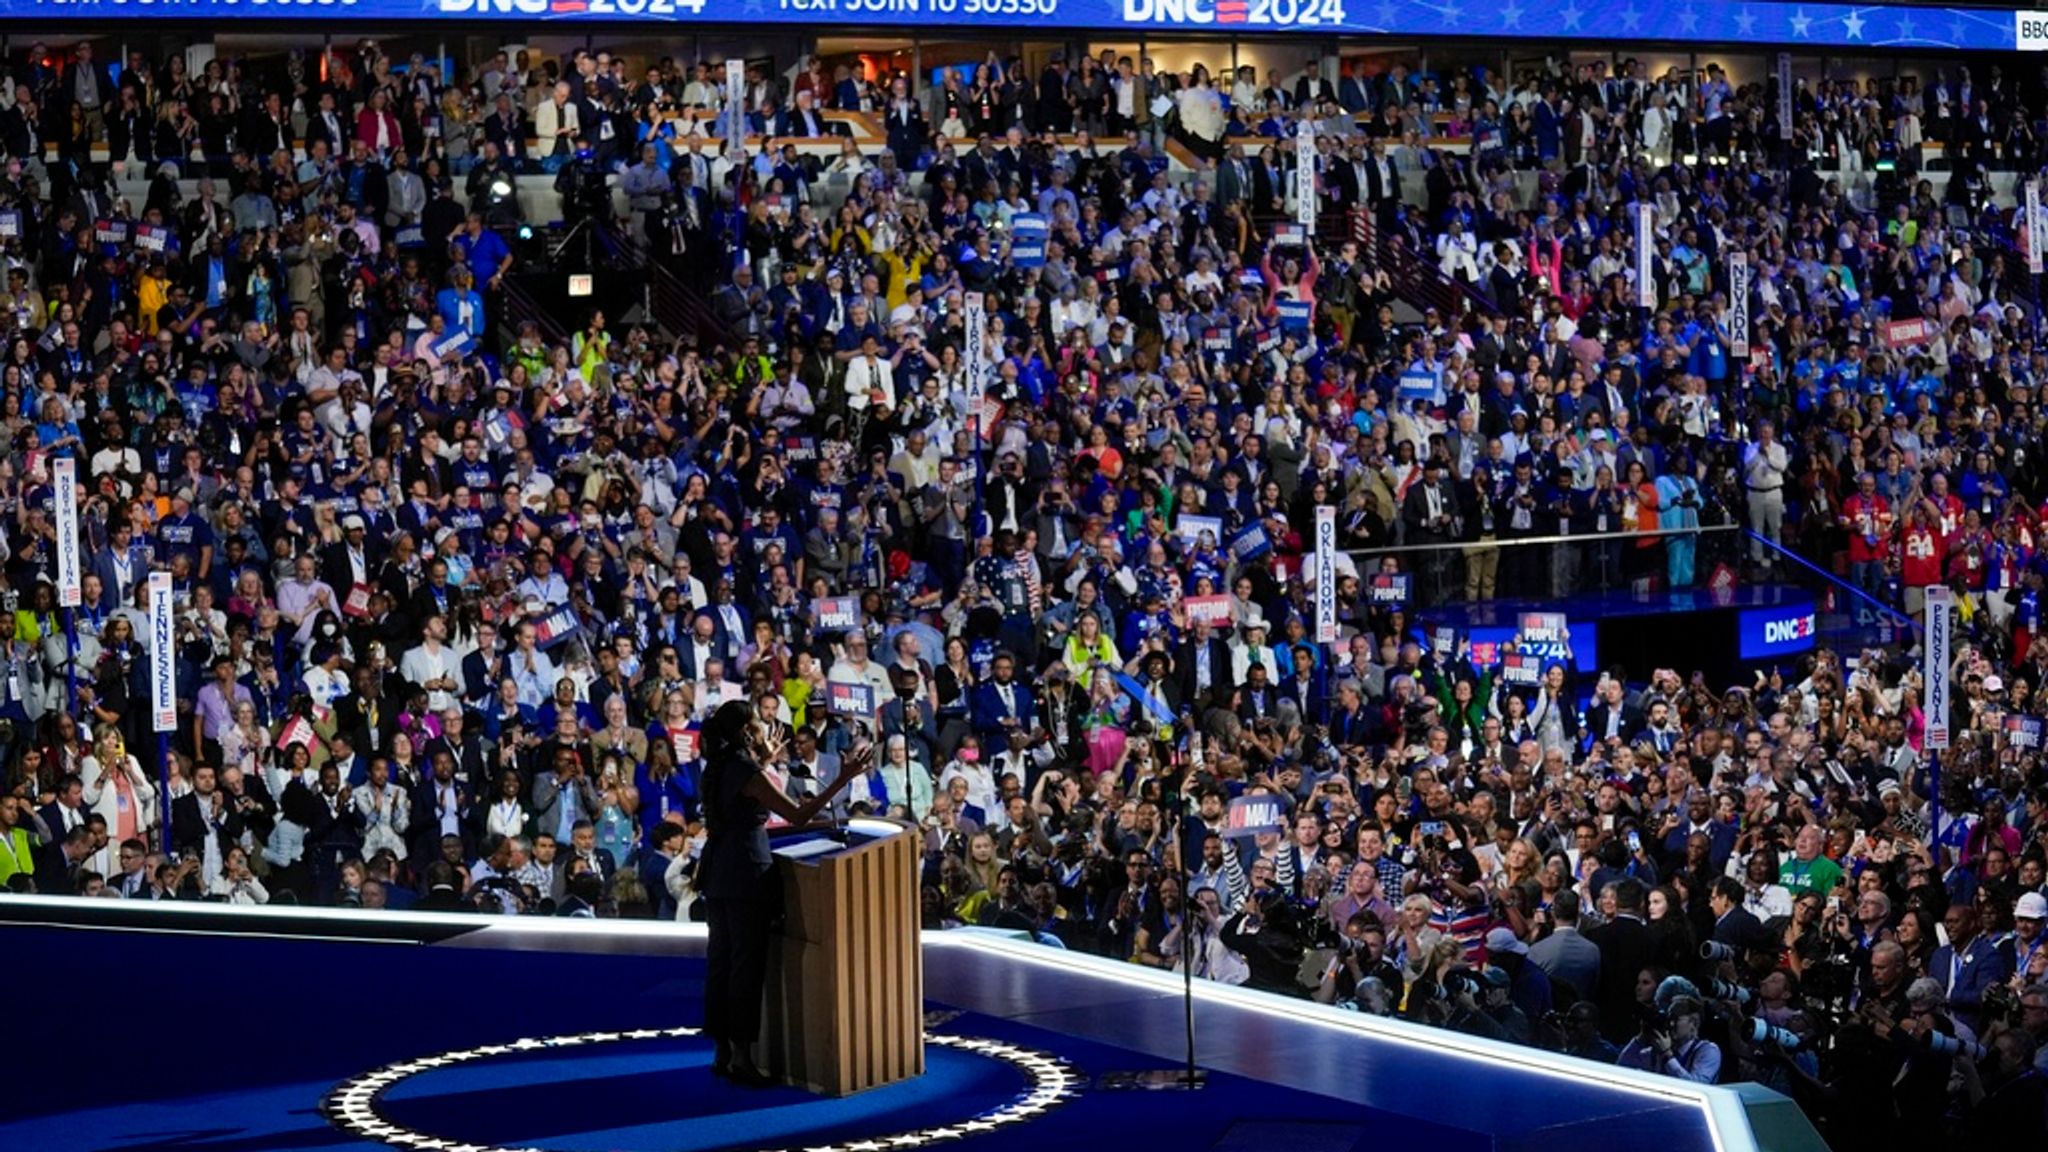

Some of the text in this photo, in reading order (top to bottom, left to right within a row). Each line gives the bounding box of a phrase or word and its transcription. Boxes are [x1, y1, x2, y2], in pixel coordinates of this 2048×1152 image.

[1123, 0, 1345, 24] DNC 2024
[1301, 145, 1312, 221] WYOMING
[1733, 264, 1745, 342] NEVADA
[969, 307, 980, 397] VIRGINIA
[62, 475, 71, 516] NORTH
[64, 521, 74, 585] CAROLINA
[1321, 522, 1332, 623] OKLAHOMA
[820, 612, 855, 628] PEOPLE
[1525, 627, 1559, 641] PEOPLE
[1765, 617, 1799, 643] DNC
[156, 590, 169, 709] TENNESSEE
[1503, 666, 1538, 682] FUTURE
[1932, 604, 1942, 725] PENNSYLVANIA
[834, 697, 868, 713] PEOPLE
